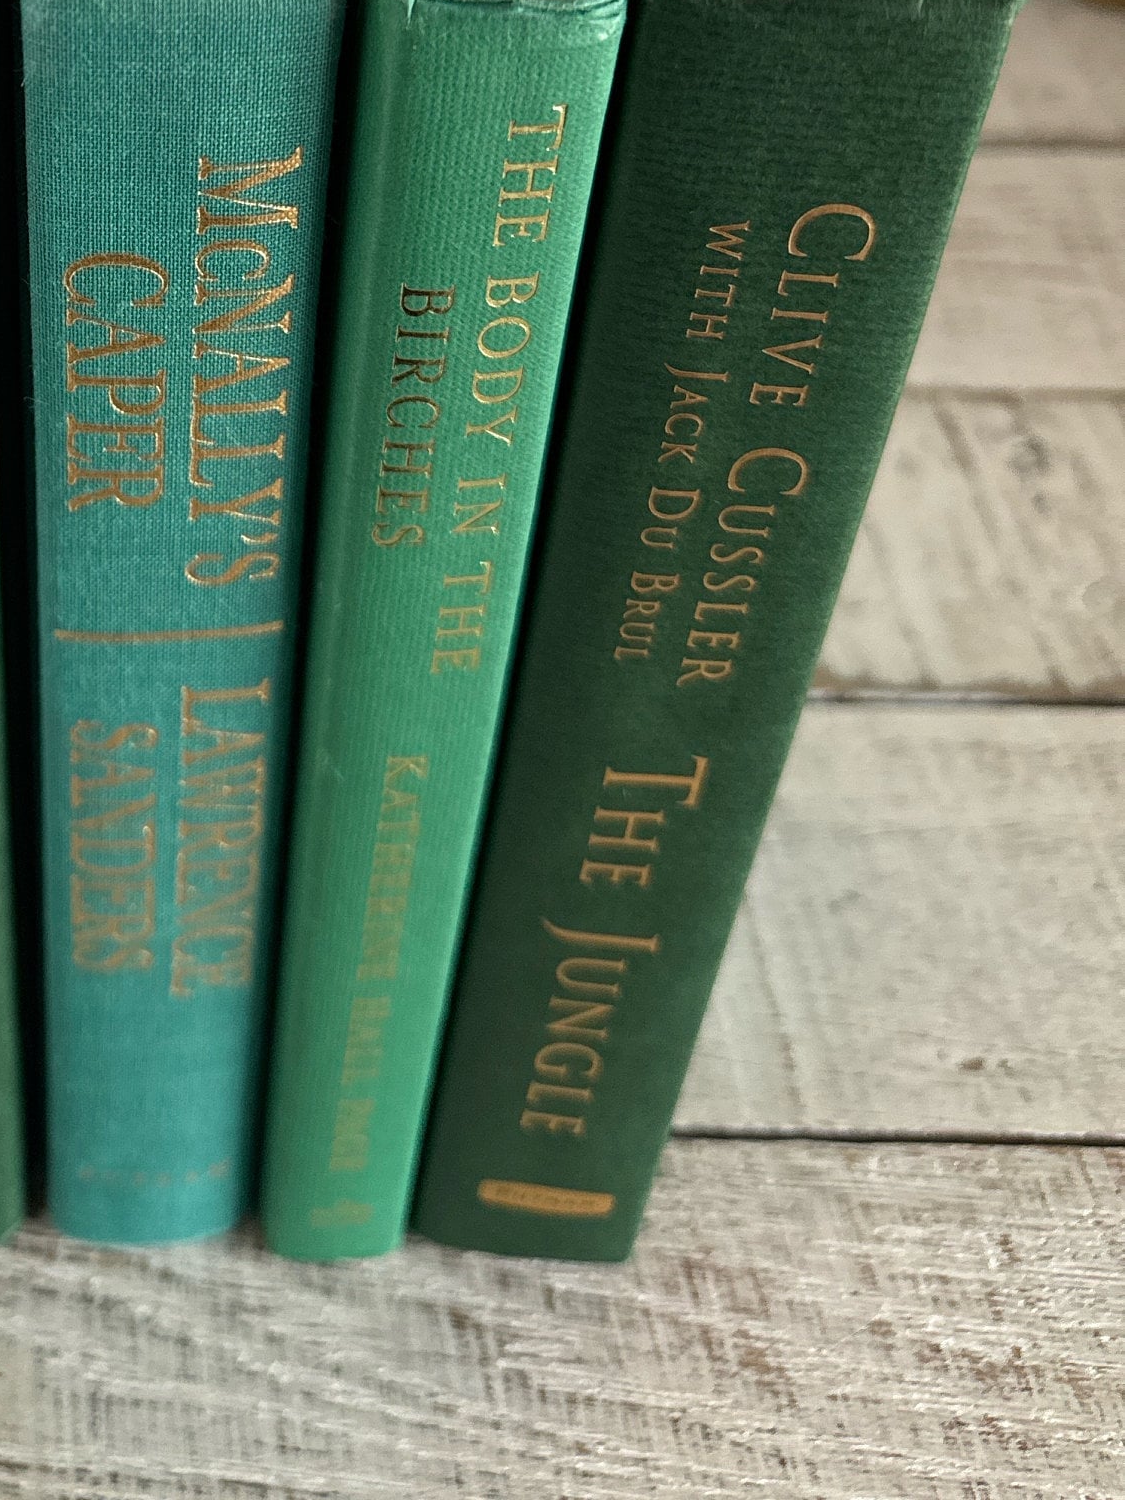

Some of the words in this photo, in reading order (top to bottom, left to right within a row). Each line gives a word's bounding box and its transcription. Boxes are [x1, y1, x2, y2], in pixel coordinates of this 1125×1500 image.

[493, 103, 568, 247] THE
[467, 271, 540, 446] BODY
[686, 220, 750, 339] WITH
[749, 203, 876, 406] CLIVE
[63, 252, 169, 511] CAPER
[372, 283, 455, 549] BIRCHES
[657, 362, 730, 464] JACK
[452, 472, 506, 536] IN
[640, 486, 701, 550] DU
[677, 447, 810, 687] CUSSLER
[430, 561, 492, 675] THE
[614, 570, 680, 661] BRUL
[69, 719, 159, 973] SANDERS
[169, 678, 272, 1000] LAWRENCE
[579, 755, 710, 889] THE
[519, 917, 661, 1137] JUNGLE
